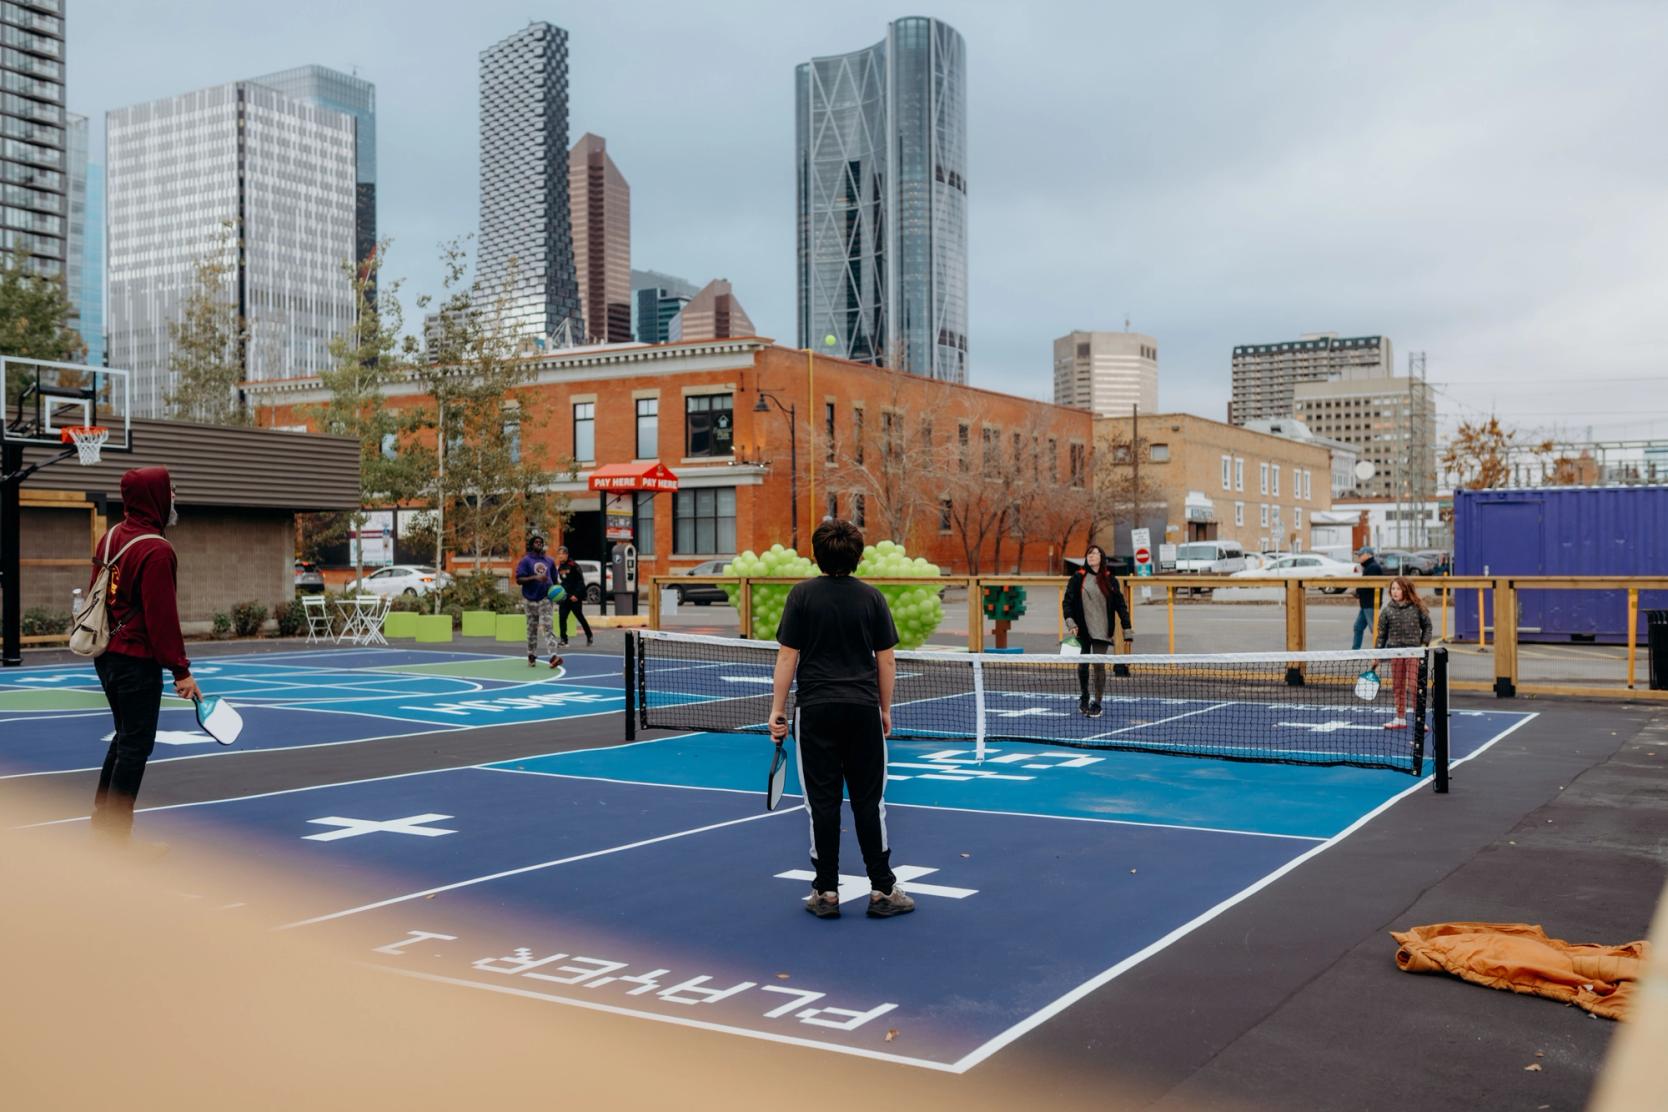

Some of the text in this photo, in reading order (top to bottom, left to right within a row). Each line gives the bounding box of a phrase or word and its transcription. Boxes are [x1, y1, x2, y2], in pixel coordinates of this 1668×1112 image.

[594, 477, 635, 487] PAY HERE
[642, 478, 678, 490] PAY HERE
[372, 930, 899, 1030] PLAYER 1
